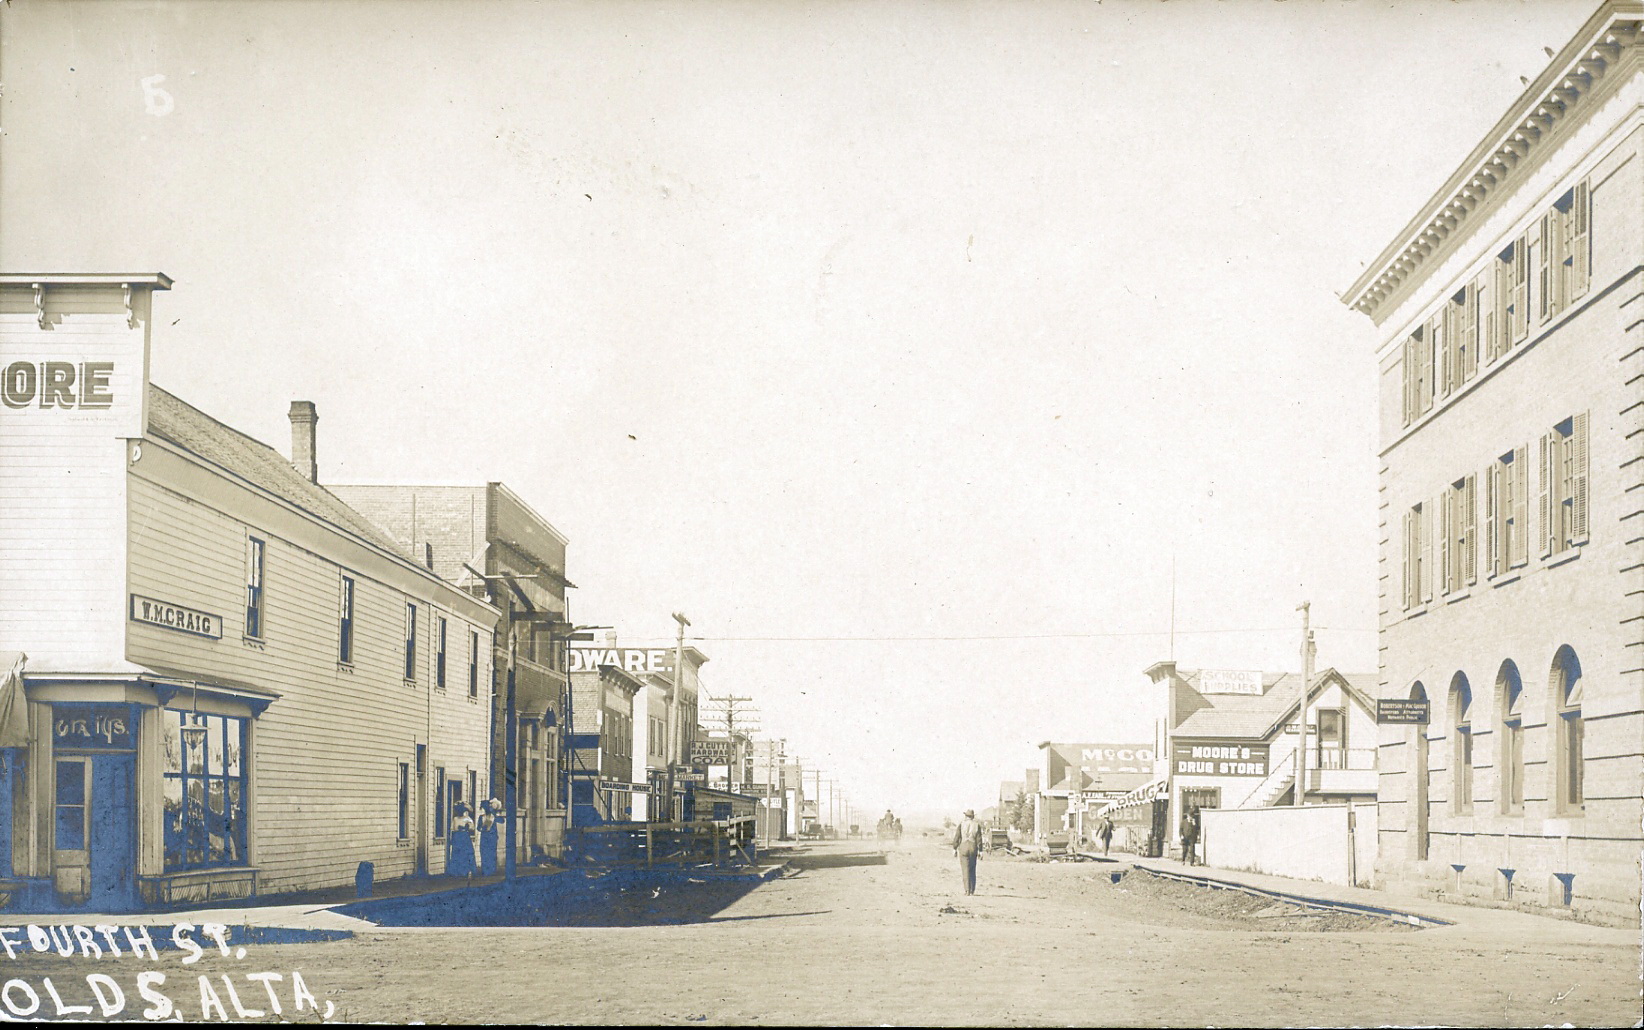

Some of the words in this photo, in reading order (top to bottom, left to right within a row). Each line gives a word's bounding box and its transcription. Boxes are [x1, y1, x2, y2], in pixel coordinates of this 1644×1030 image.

[1, 361, 114, 410] ORE
[1192, 745, 1250, 759] MOORE'S
[1178, 761, 1214, 773] DRUG
[1219, 762, 1264, 774] STORE
[632, 784, 651, 792] HOUSE
[1088, 806, 1143, 820] GDEN
